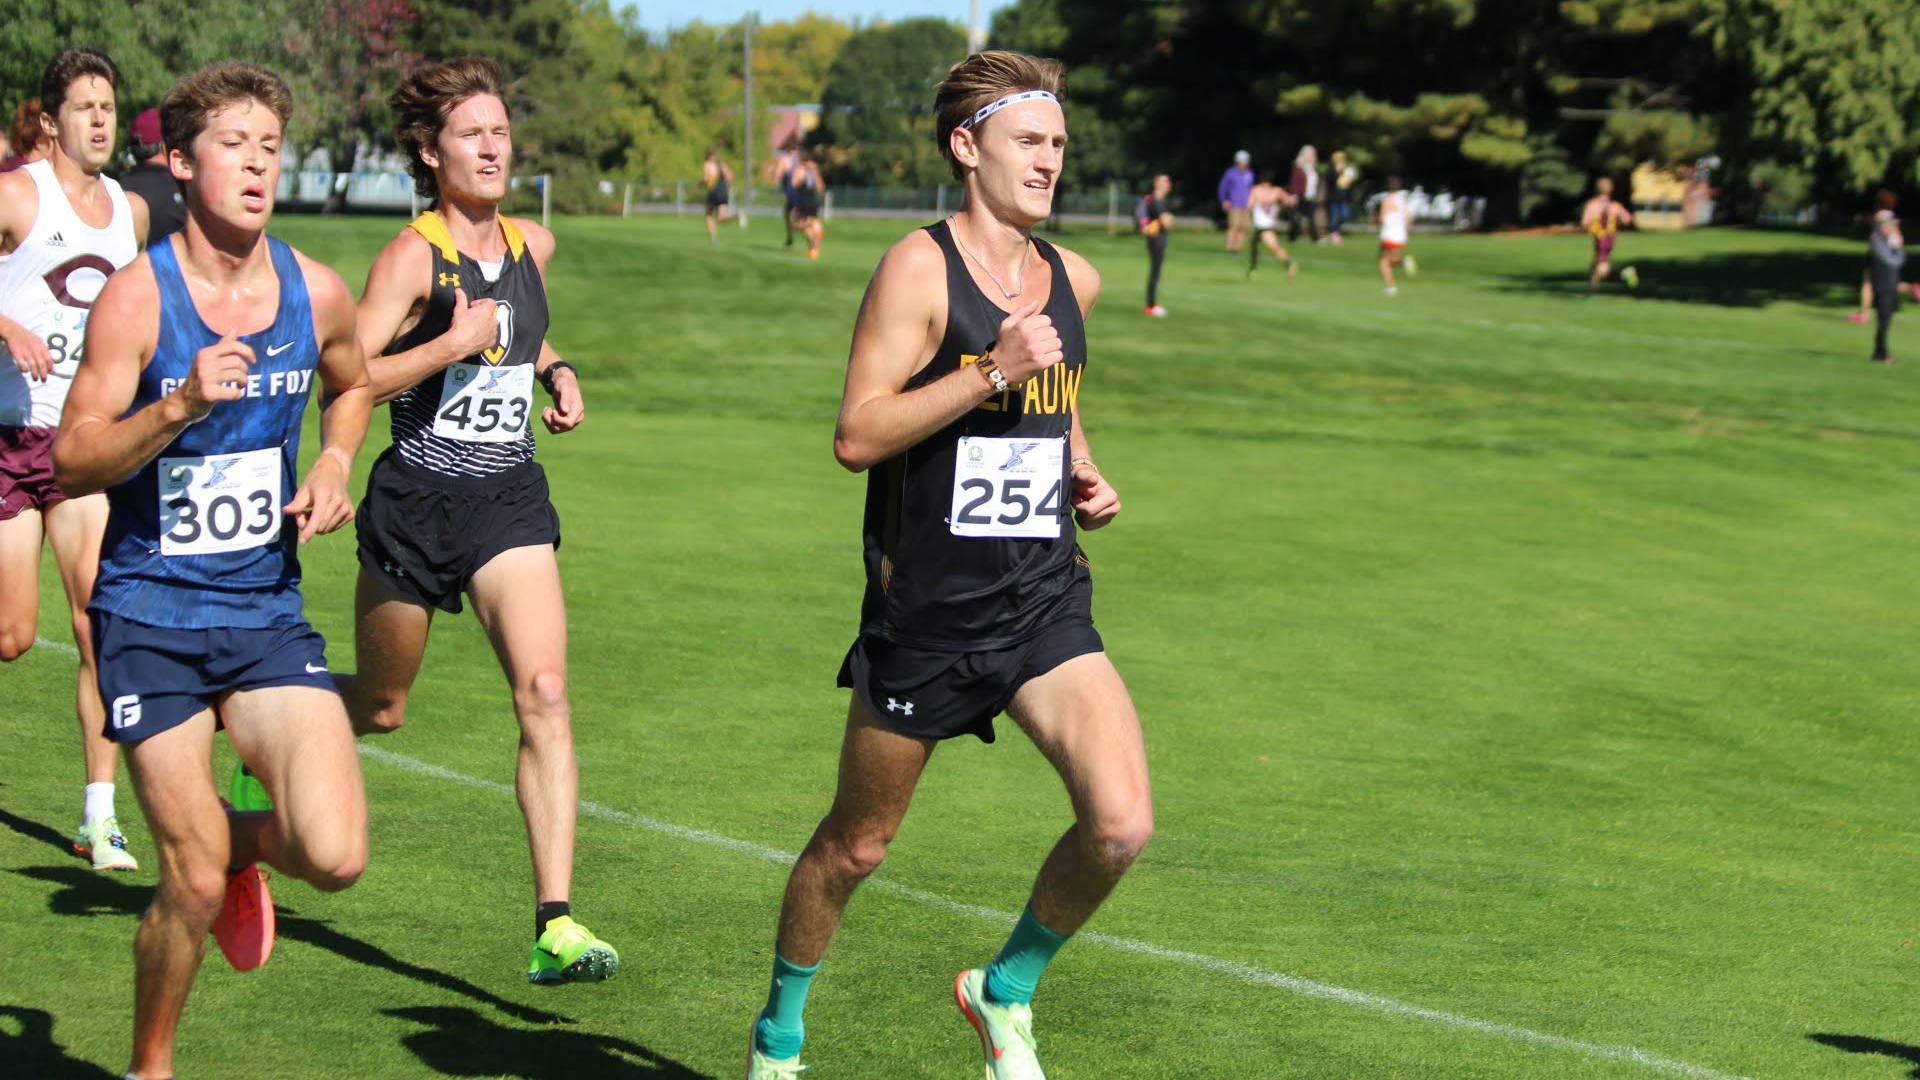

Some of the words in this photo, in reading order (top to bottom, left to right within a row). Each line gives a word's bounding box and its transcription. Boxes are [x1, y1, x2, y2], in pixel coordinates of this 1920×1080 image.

[270, 369, 312, 396] FOX
[440, 395, 528, 433] 453
[166, 489, 274, 544] 303
[957, 477, 1062, 525] 254
